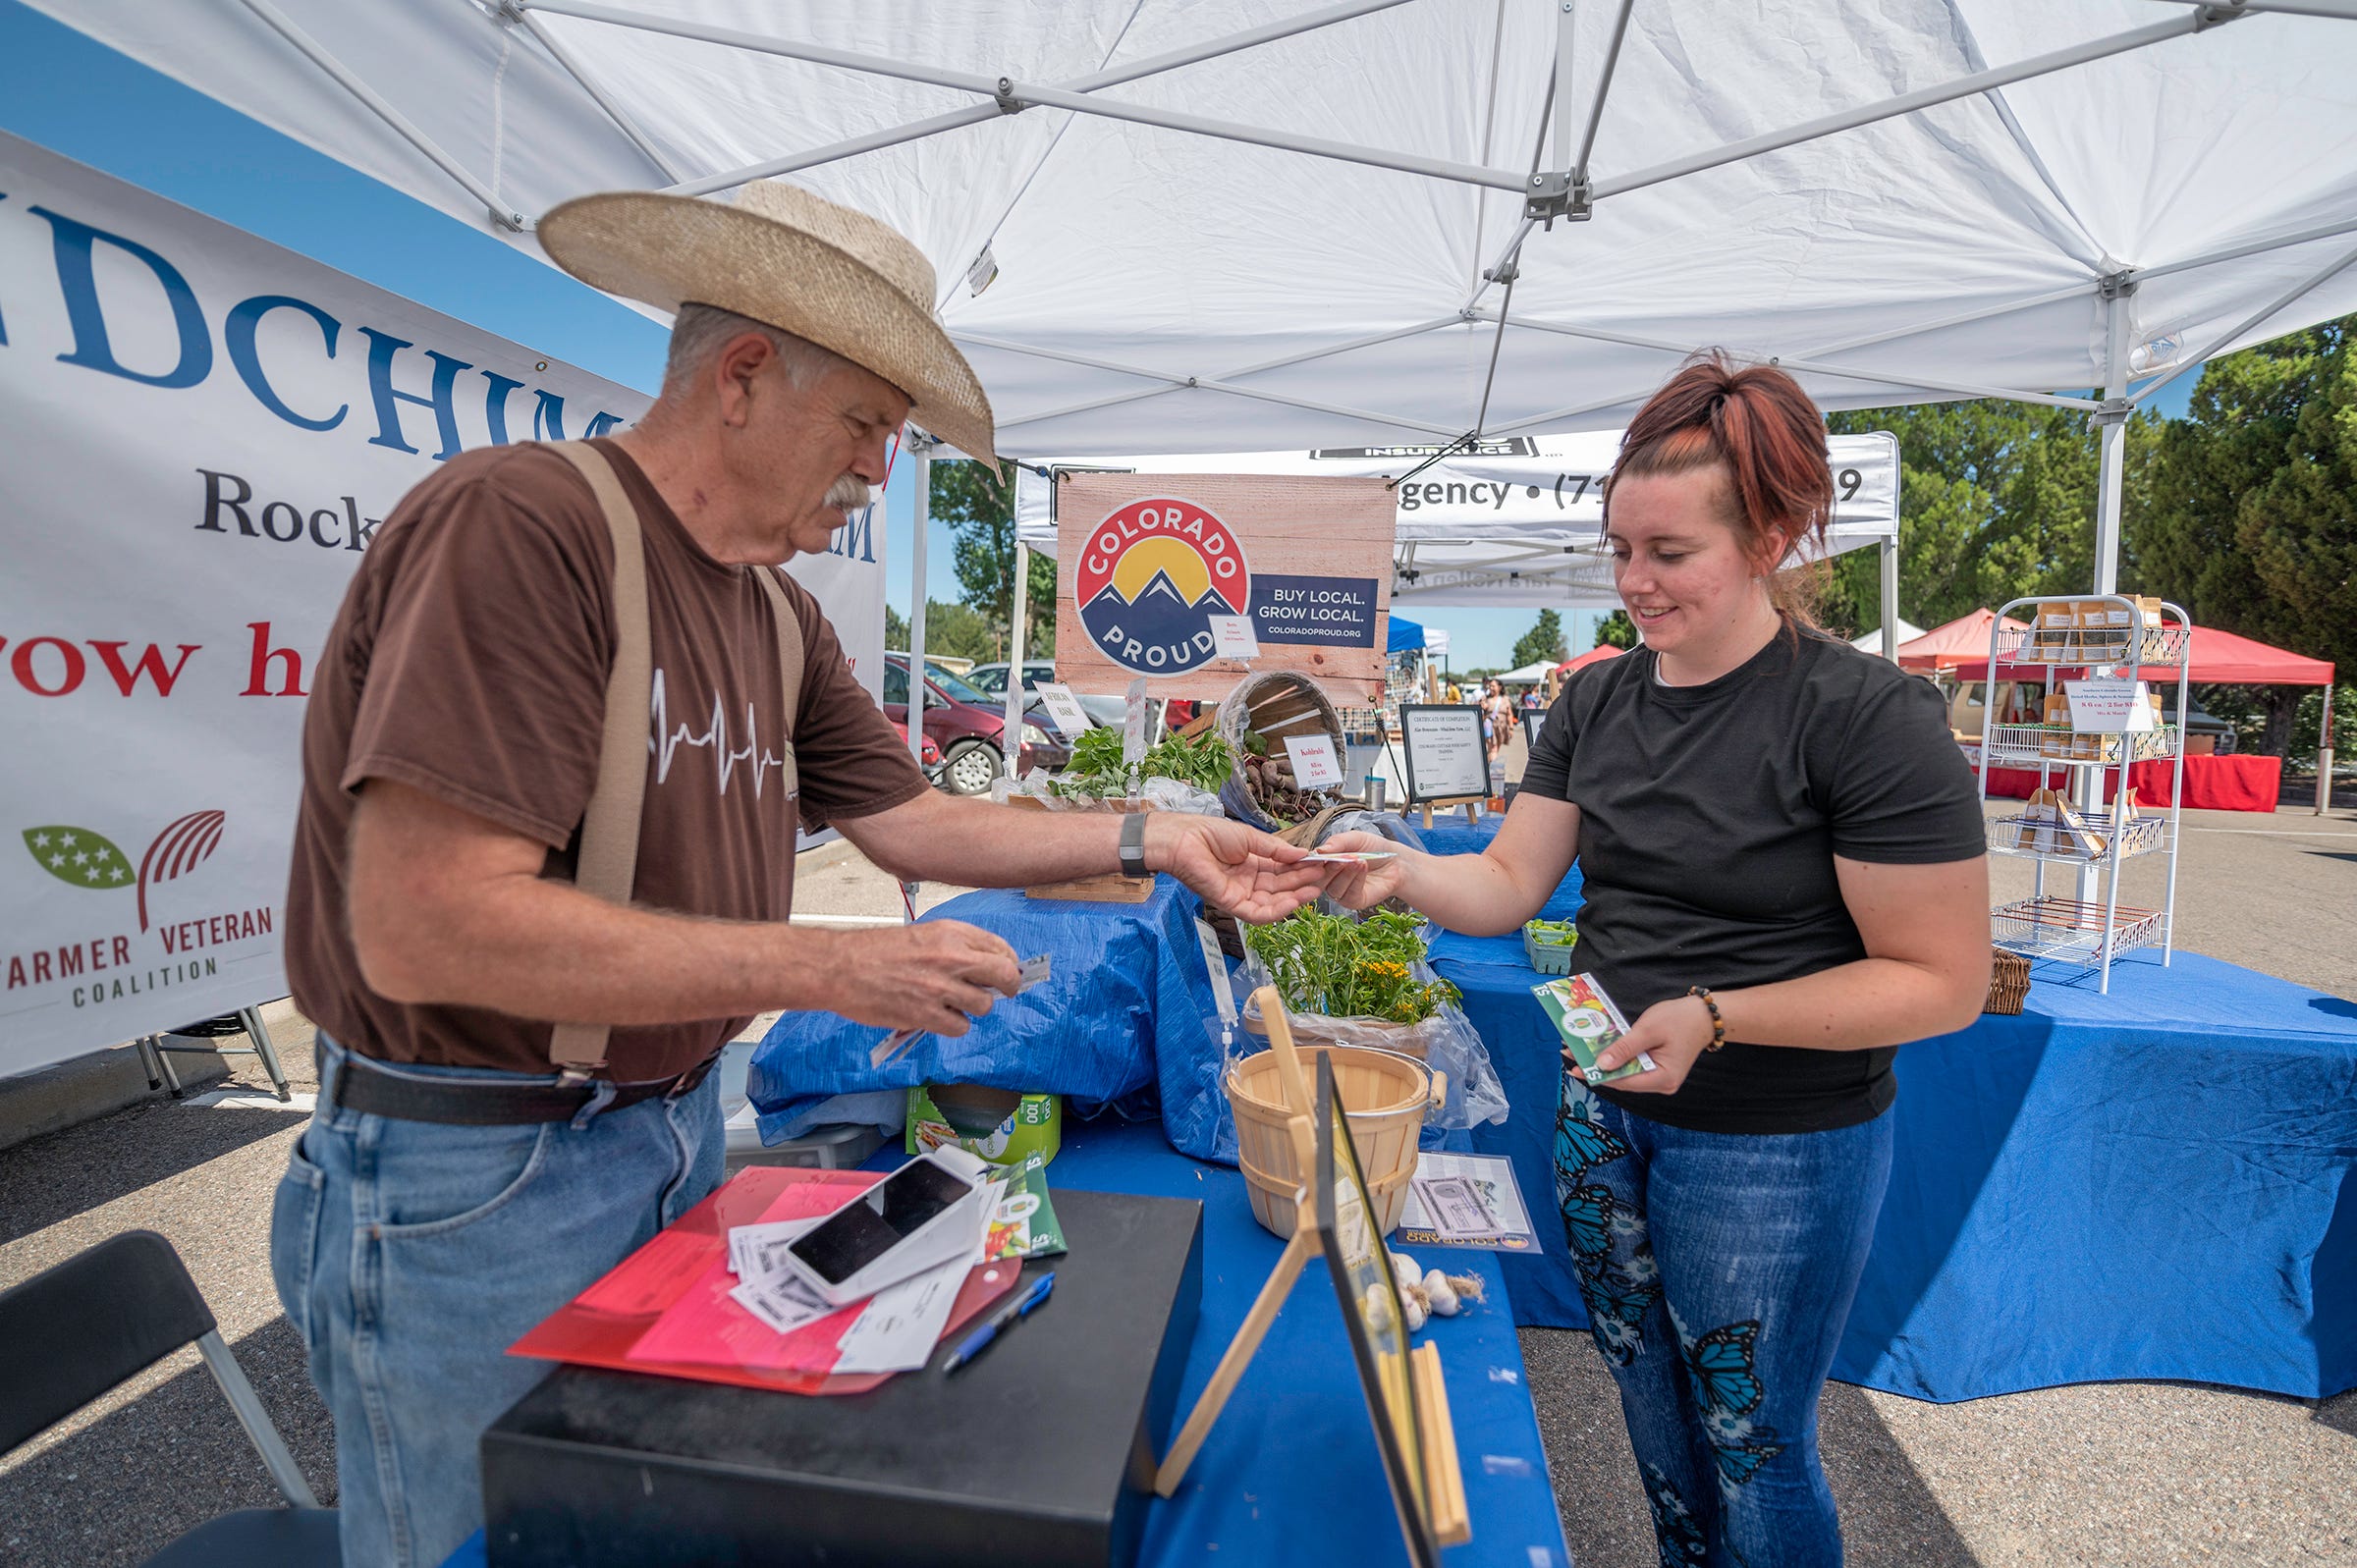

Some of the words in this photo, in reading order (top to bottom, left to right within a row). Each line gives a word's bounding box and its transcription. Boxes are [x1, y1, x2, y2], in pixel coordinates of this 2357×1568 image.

[1364, 445, 1512, 457] INSURANCE
[1397, 481, 1511, 511] gency
[1087, 507, 1237, 579] COLORADO
[1274, 589, 1307, 602] BUY
[1309, 591, 1365, 605] LOCAL.
[1258, 606, 1307, 620] GROW
[1310, 608, 1365, 622] LOCAL.
[1102, 624, 1215, 668] PROUD
[1268, 625, 1361, 637] COLORADOPROUD.ORG
[0, 629, 203, 698] ow
[0, 935, 132, 991] ARMER
[159, 906, 273, 955] VETERAN
[72, 957, 218, 1008] COALITION
[1026, 1103, 1038, 1124] 100
